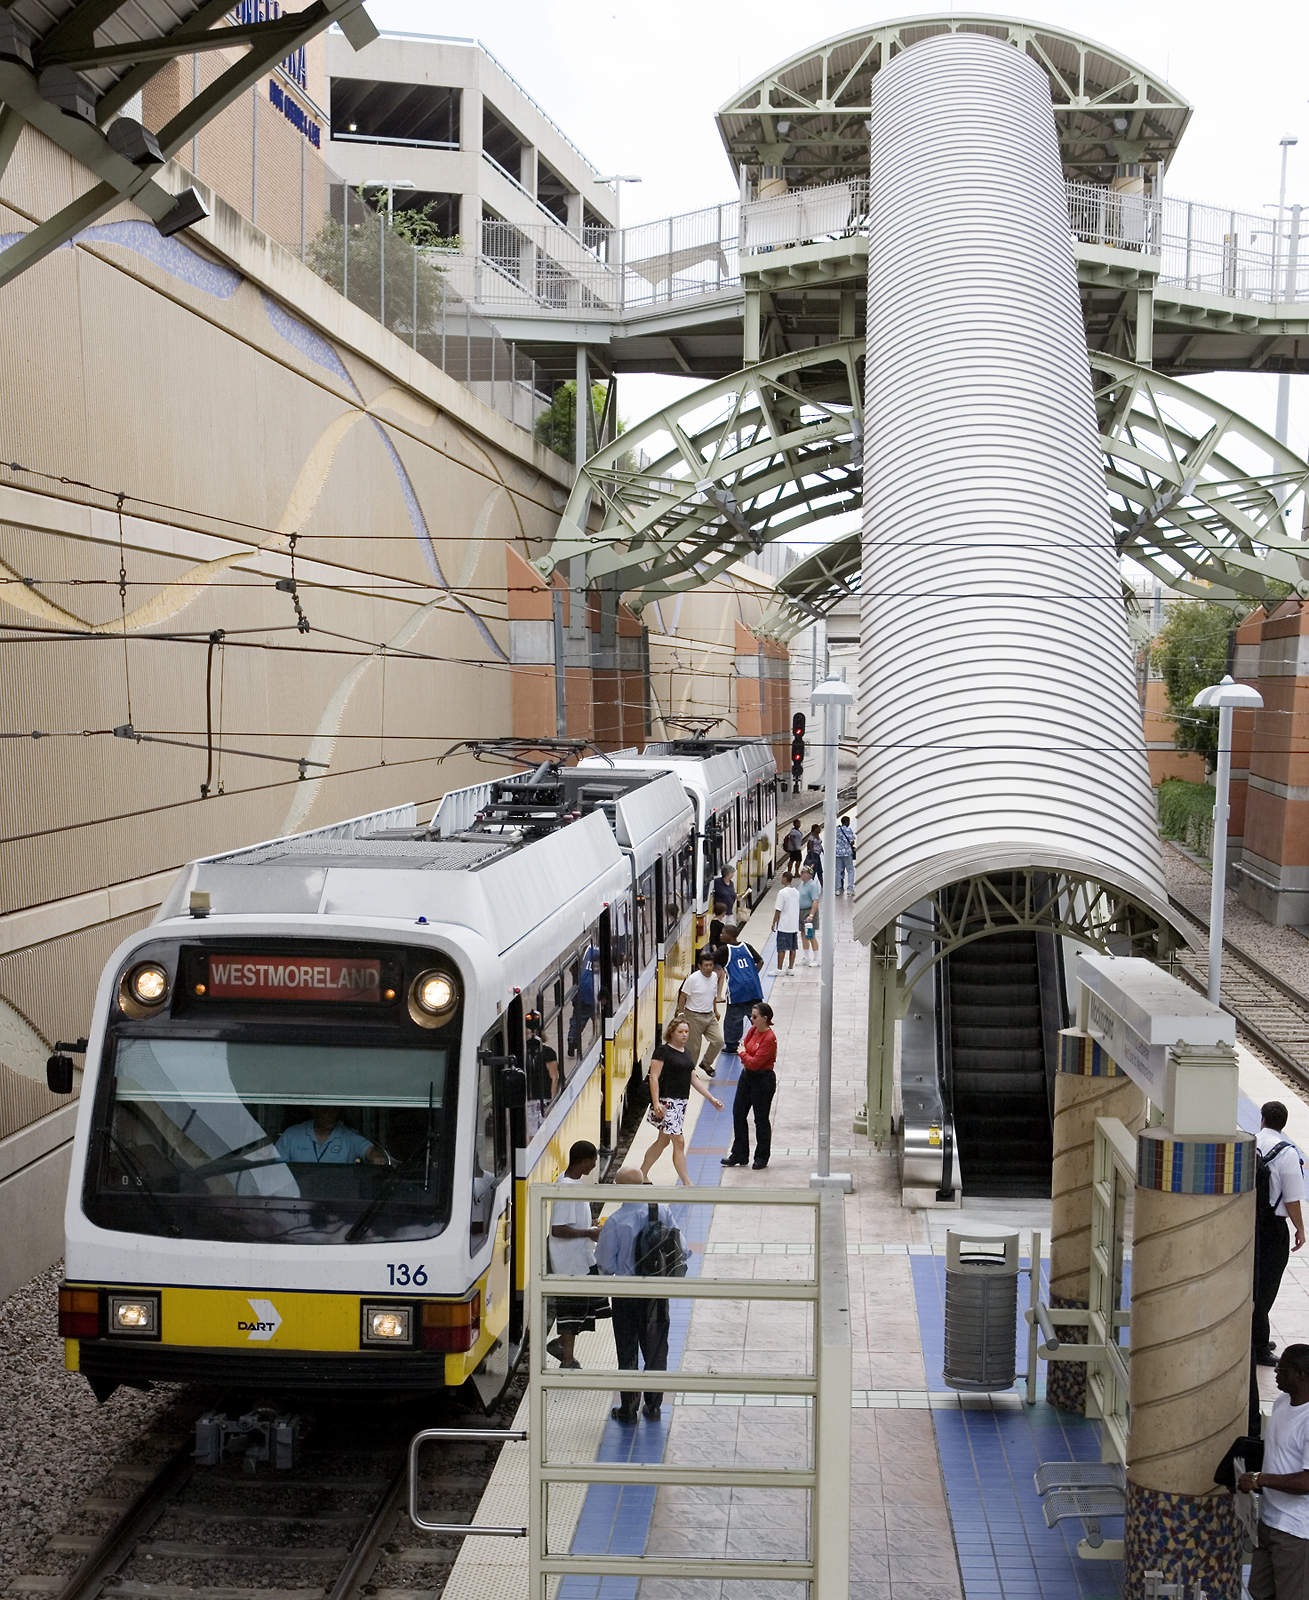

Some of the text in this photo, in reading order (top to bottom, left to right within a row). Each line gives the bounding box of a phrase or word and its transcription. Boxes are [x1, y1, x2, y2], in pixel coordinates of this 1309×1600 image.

[737, 958, 749, 969] 01
[211, 963, 379, 989] WESTMORELAND
[387, 1263, 428, 1287] 136
[237, 1321, 275, 1332] DART
